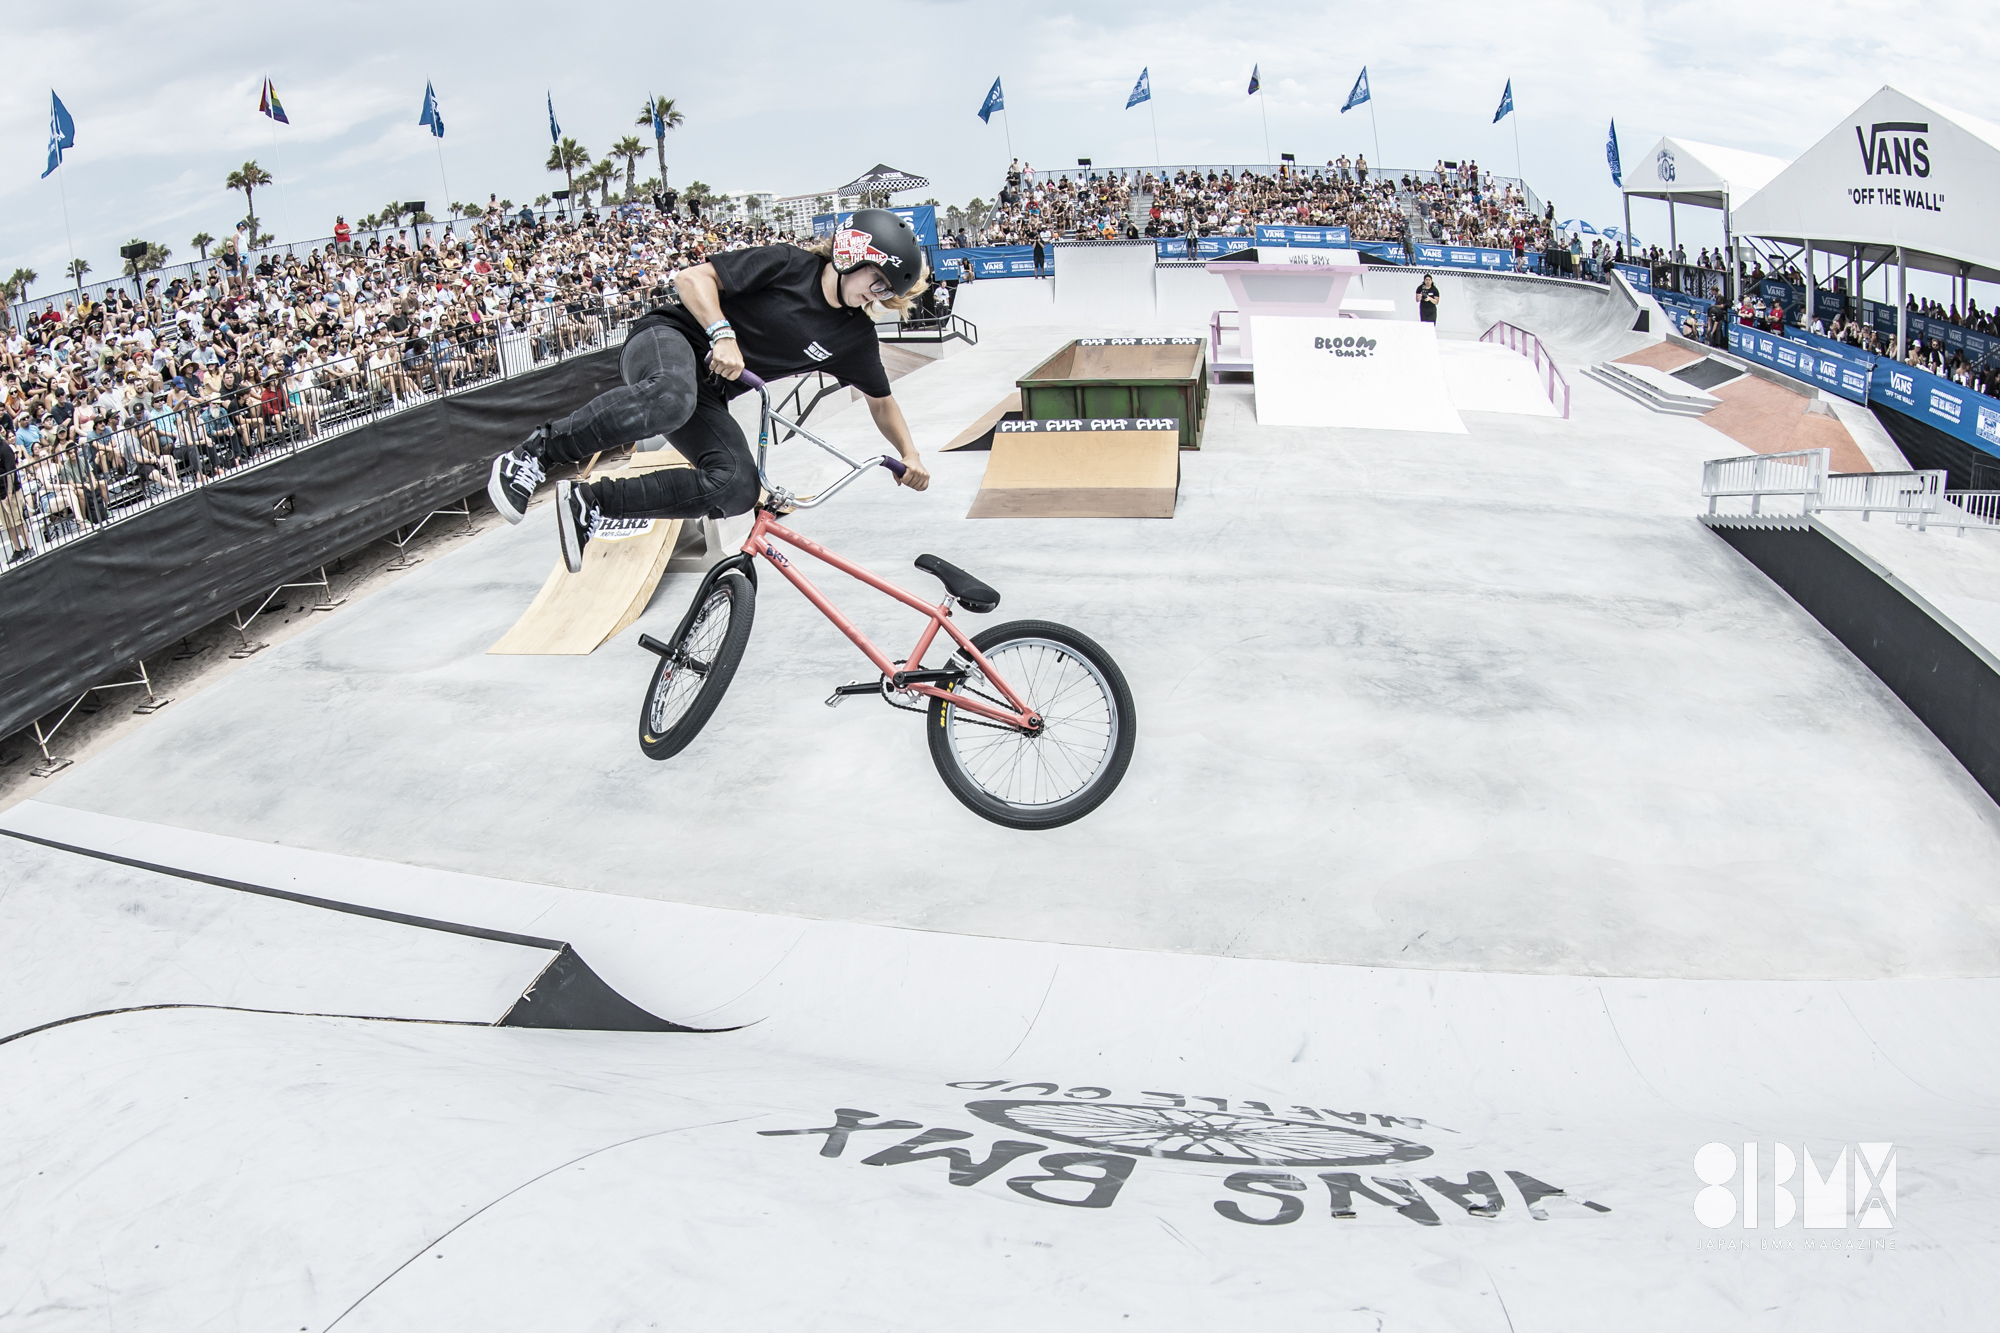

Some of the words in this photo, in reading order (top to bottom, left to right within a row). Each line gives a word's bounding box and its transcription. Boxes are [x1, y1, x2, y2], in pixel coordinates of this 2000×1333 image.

[1855, 121, 1930, 178] VANS
[1847, 188, 1875, 205] "OFF
[1878, 188, 1901, 206] THE
[1903, 189, 1945, 212] WALL"
[1263, 229, 1285, 238] VANS
[1226, 241, 1248, 250] VANS
[1421, 248, 1442, 258] VANS
[983, 261, 1004, 270] VANS
[1289, 254, 1309, 265] VANS
[1766, 285, 1786, 297] VANS
[1821, 296, 1840, 308] VANS
[1314, 336, 1377, 351] BLOOM
[1759, 338, 1774, 354] VANS
[1820, 360, 1837, 378] VANS
[1890, 370, 1913, 395] VANS
[598, 518, 649, 530] HAKE
[945, 1079, 1112, 1100] CUP
[757, 1108, 1138, 1209] BMX
[1213, 1170, 1612, 1227] VANS
